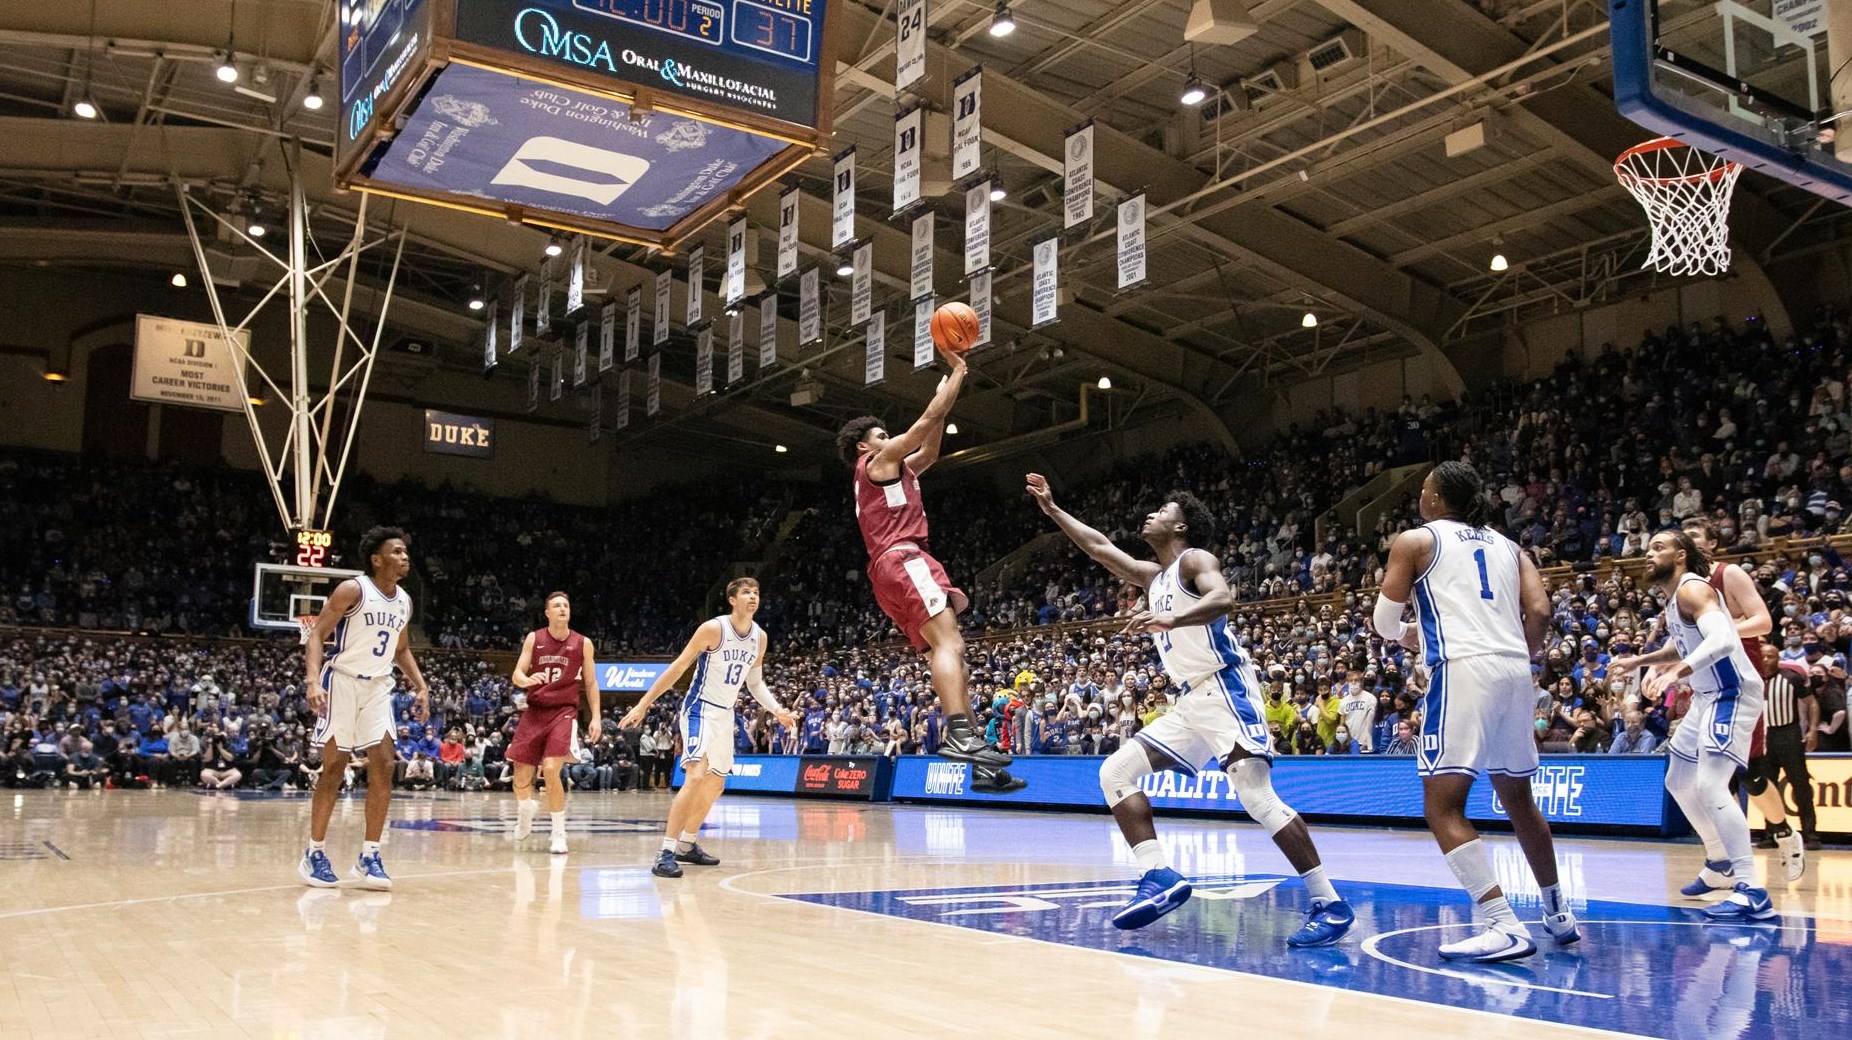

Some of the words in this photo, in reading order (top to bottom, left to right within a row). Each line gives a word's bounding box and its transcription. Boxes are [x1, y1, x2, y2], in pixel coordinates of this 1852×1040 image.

[692, 3, 720, 19] PERIOD
[700, 16, 711, 36] 2
[757, 10, 795, 50] 37
[901, 7, 922, 42] 24
[520, 97, 560, 116] Duke
[152, 376, 186, 388] CAREER
[188, 381, 231, 393] VICTORIES
[180, 370, 205, 380] MOST
[430, 423, 489, 447] DUKE
[298, 532, 331, 547] 12:00
[297, 545, 325, 567] 22
[1473, 549, 1494, 600] 1
[364, 612, 404, 632] DUKE
[372, 631, 390, 657] 3
[723, 649, 756, 665] DUKE
[543, 667, 561, 684] 12
[724, 663, 743, 686] 13
[838, 779, 860, 789] SUGAR
[1137, 769, 1236, 799] UALITY
